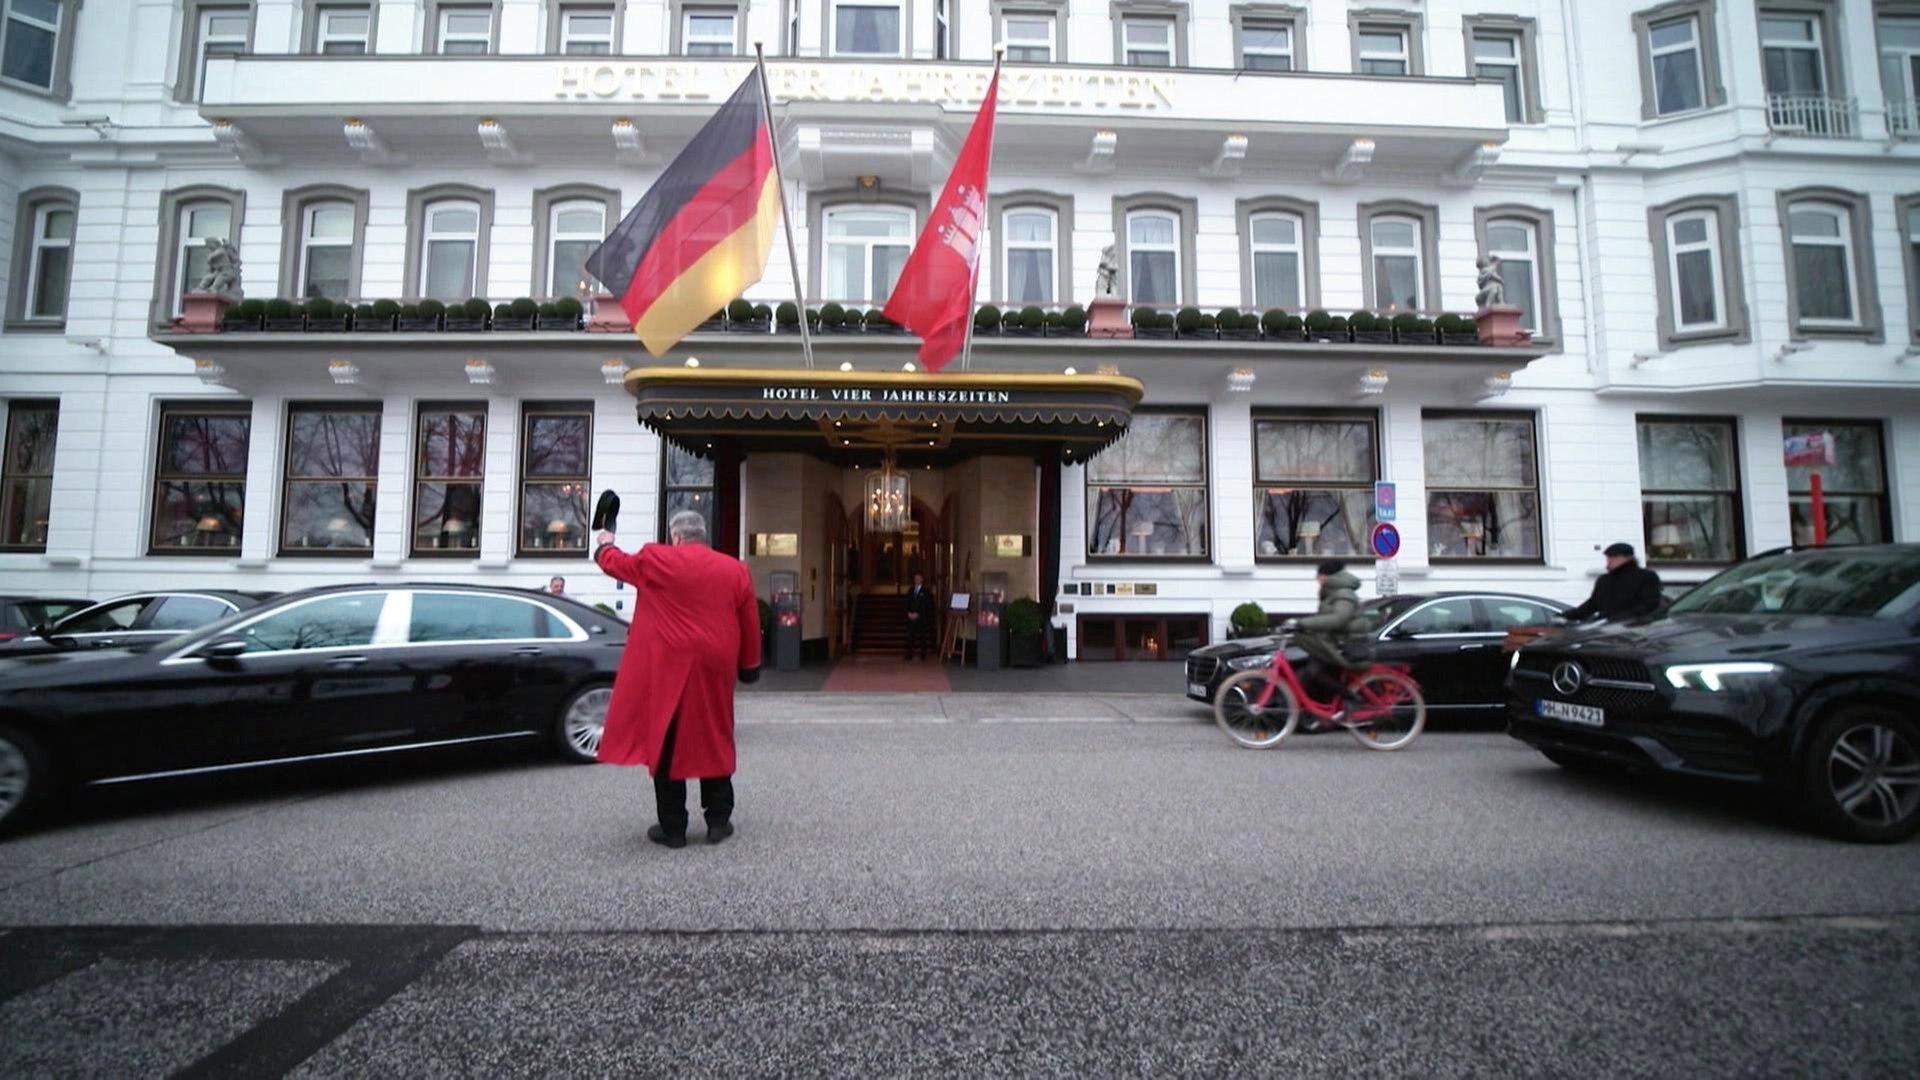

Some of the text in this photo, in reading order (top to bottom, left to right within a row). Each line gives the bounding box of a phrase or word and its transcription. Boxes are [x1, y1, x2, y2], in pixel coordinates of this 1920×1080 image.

[555, 65, 1175, 107] HOTEL VER JAHRESZEITEN
[763, 388, 1009, 402] HOTEL VIER JAHRESZEITEN
